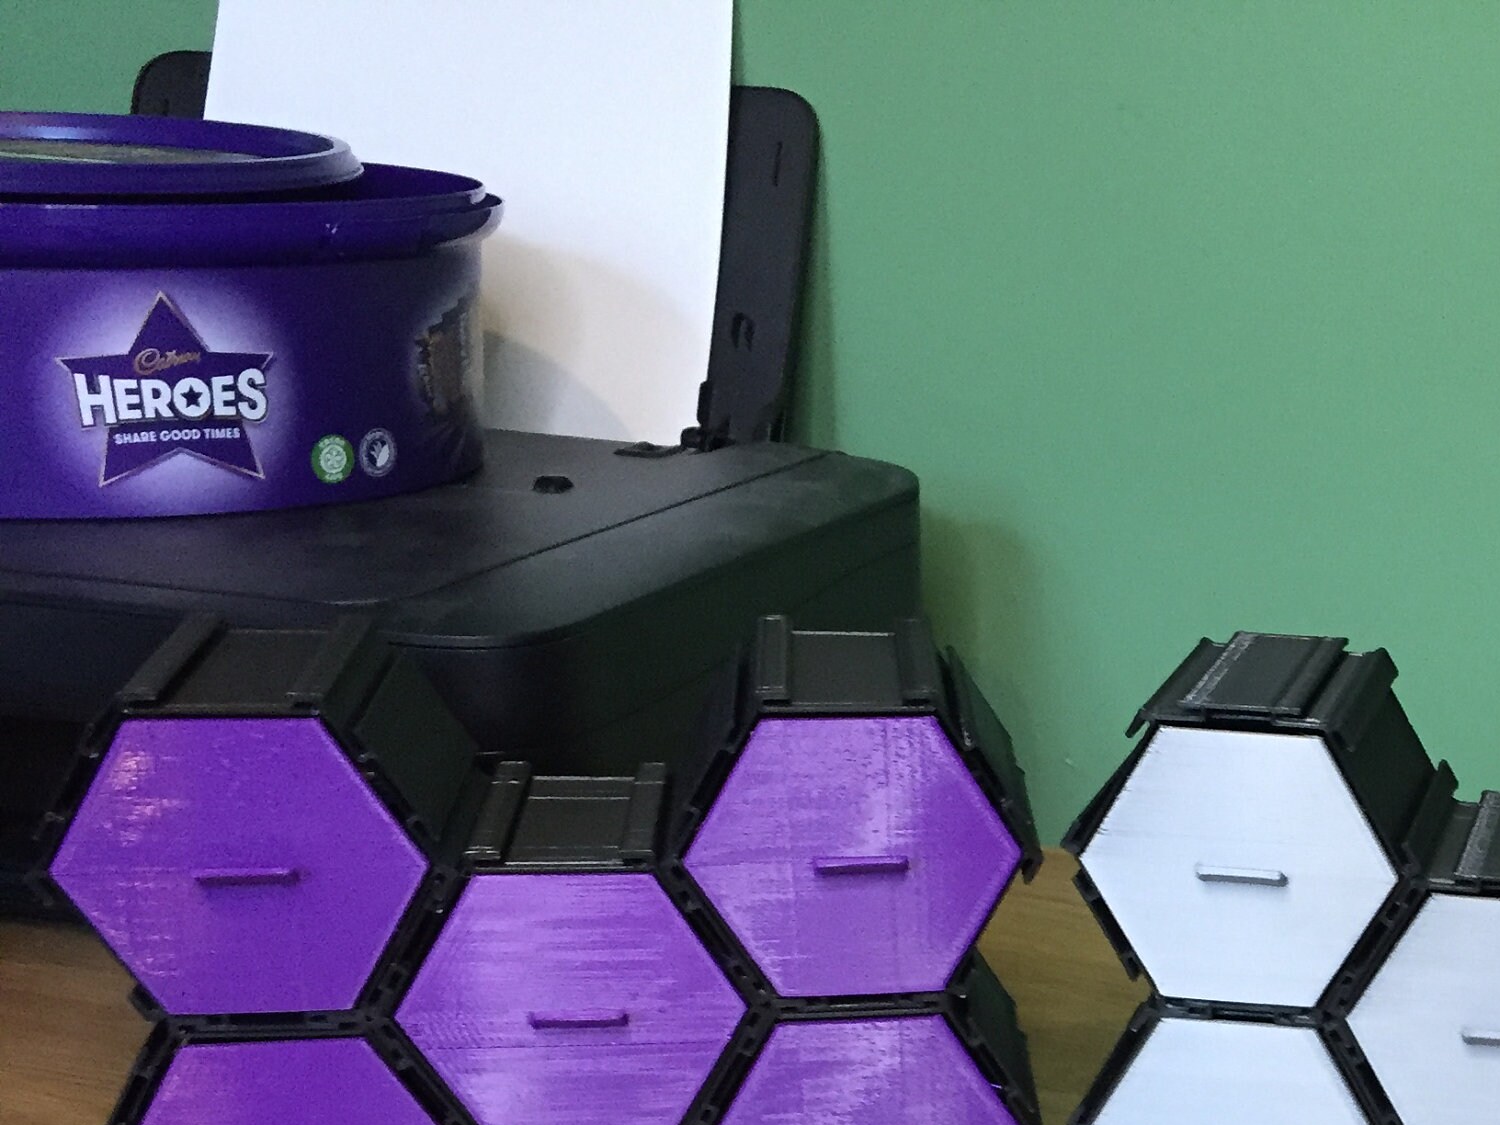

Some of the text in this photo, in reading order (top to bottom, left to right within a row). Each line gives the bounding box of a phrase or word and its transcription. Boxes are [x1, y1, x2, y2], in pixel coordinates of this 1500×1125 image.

[73, 368, 267, 426] HEROES
[113, 427, 241, 444] SHARE GOOD TIMES
